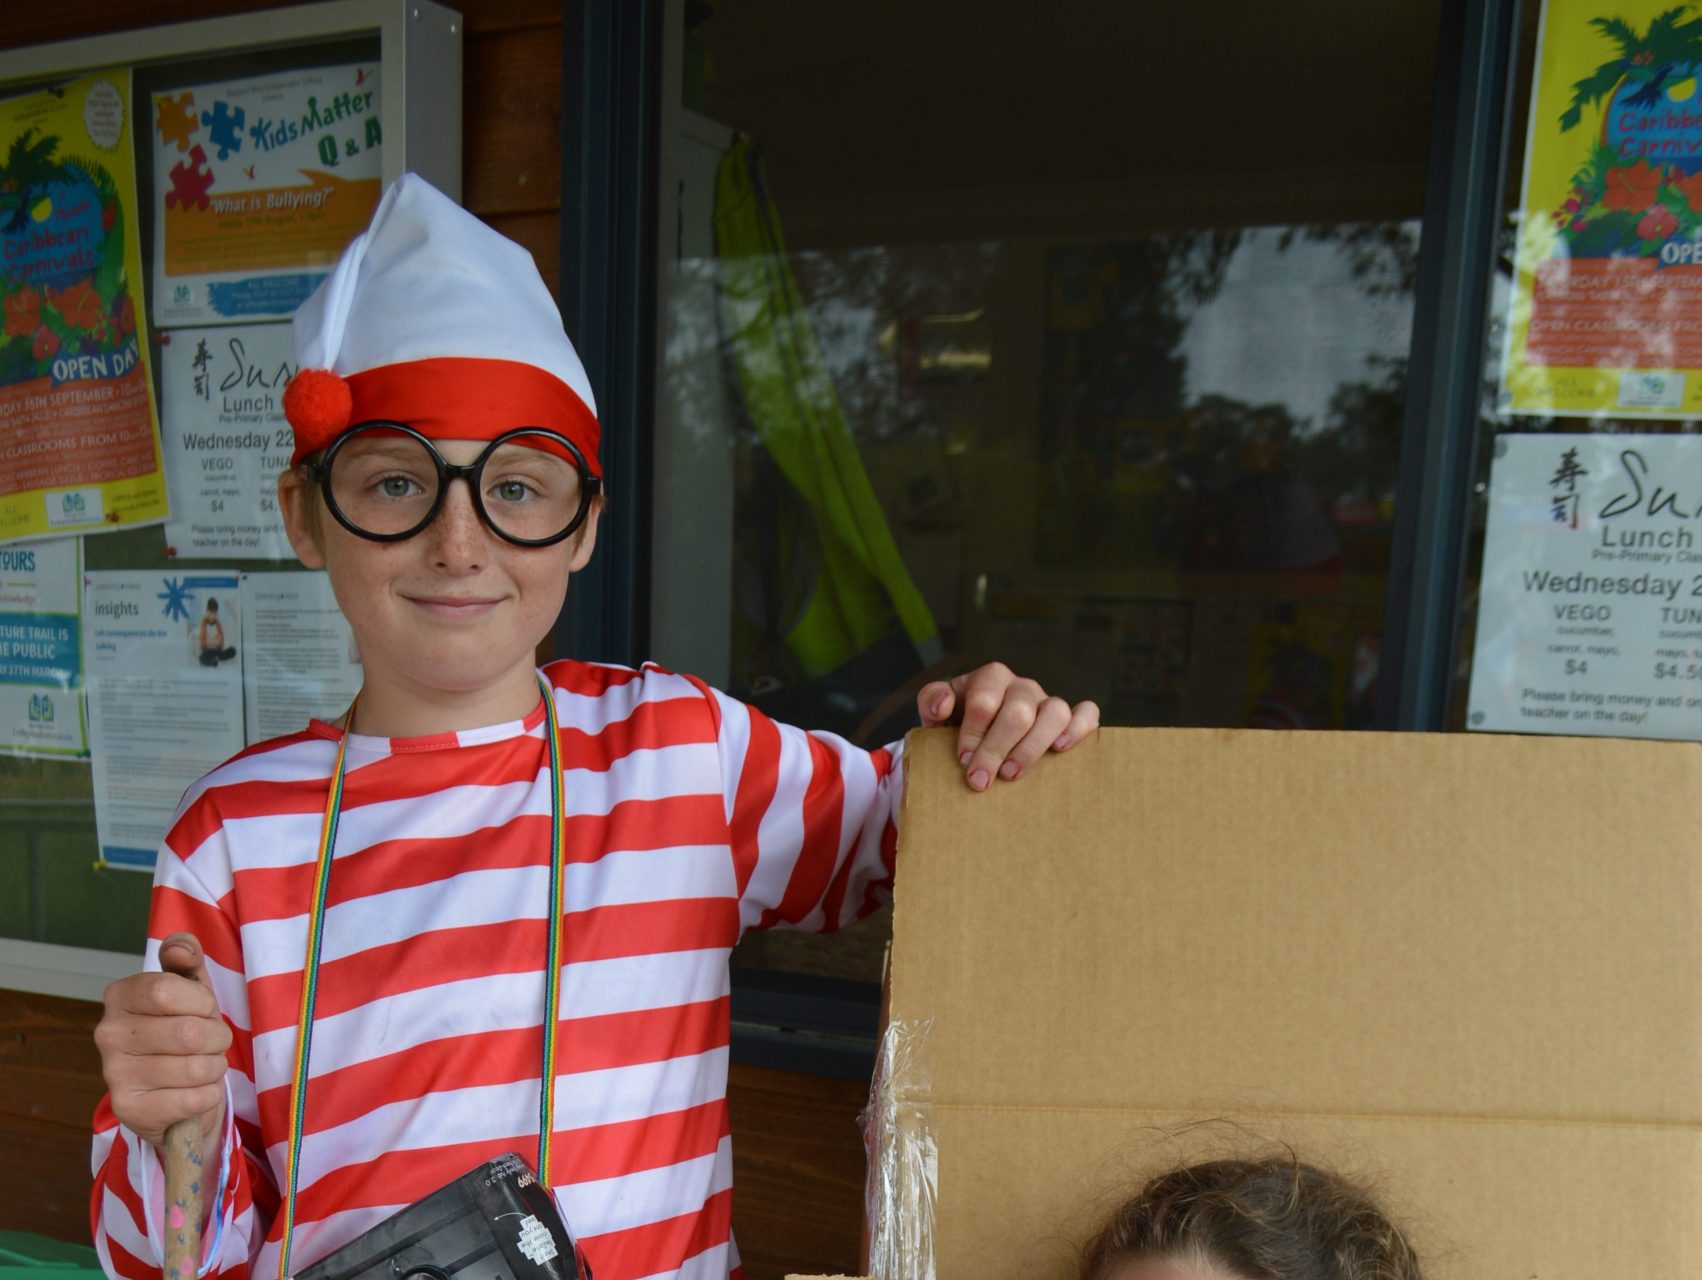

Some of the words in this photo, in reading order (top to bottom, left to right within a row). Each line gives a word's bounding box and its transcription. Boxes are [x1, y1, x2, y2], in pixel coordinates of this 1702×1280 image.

[318, 133, 339, 167] Q
[345, 138, 360, 157] &
[364, 116, 382, 149] A
[251, 196, 261, 210] is
[52, 354, 108, 381] OPEN
[112, 340, 139, 377] DAY
[223, 394, 274, 413] Lunch
[80, 433, 116, 447] FROM
[182, 431, 271, 452] Wednesday
[201, 457, 234, 471] VEGO
[216, 524, 235, 535] bring
[237, 524, 261, 535] money
[1602, 526, 1693, 548] Lunch
[192, 537, 219, 547] teacher
[231, 537, 243, 546] the
[1523, 569, 1682, 602] Wednesday
[95, 600, 140, 620] insights
[1554, 604, 1612, 622] VEGO
[30, 626, 57, 641] TRAIL
[59, 628, 69, 641] IS
[12, 643, 56, 659] PUBLIC
[1564, 658, 1588, 675] $4
[1521, 687, 1566, 701] Please
[1569, 690, 1604, 706] bring
[1606, 693, 1652, 707] money
[1656, 695, 1682, 707] and
[1521, 706, 1570, 719] teacher
[1573, 708, 1590, 719] on
[1592, 709, 1616, 721] the
